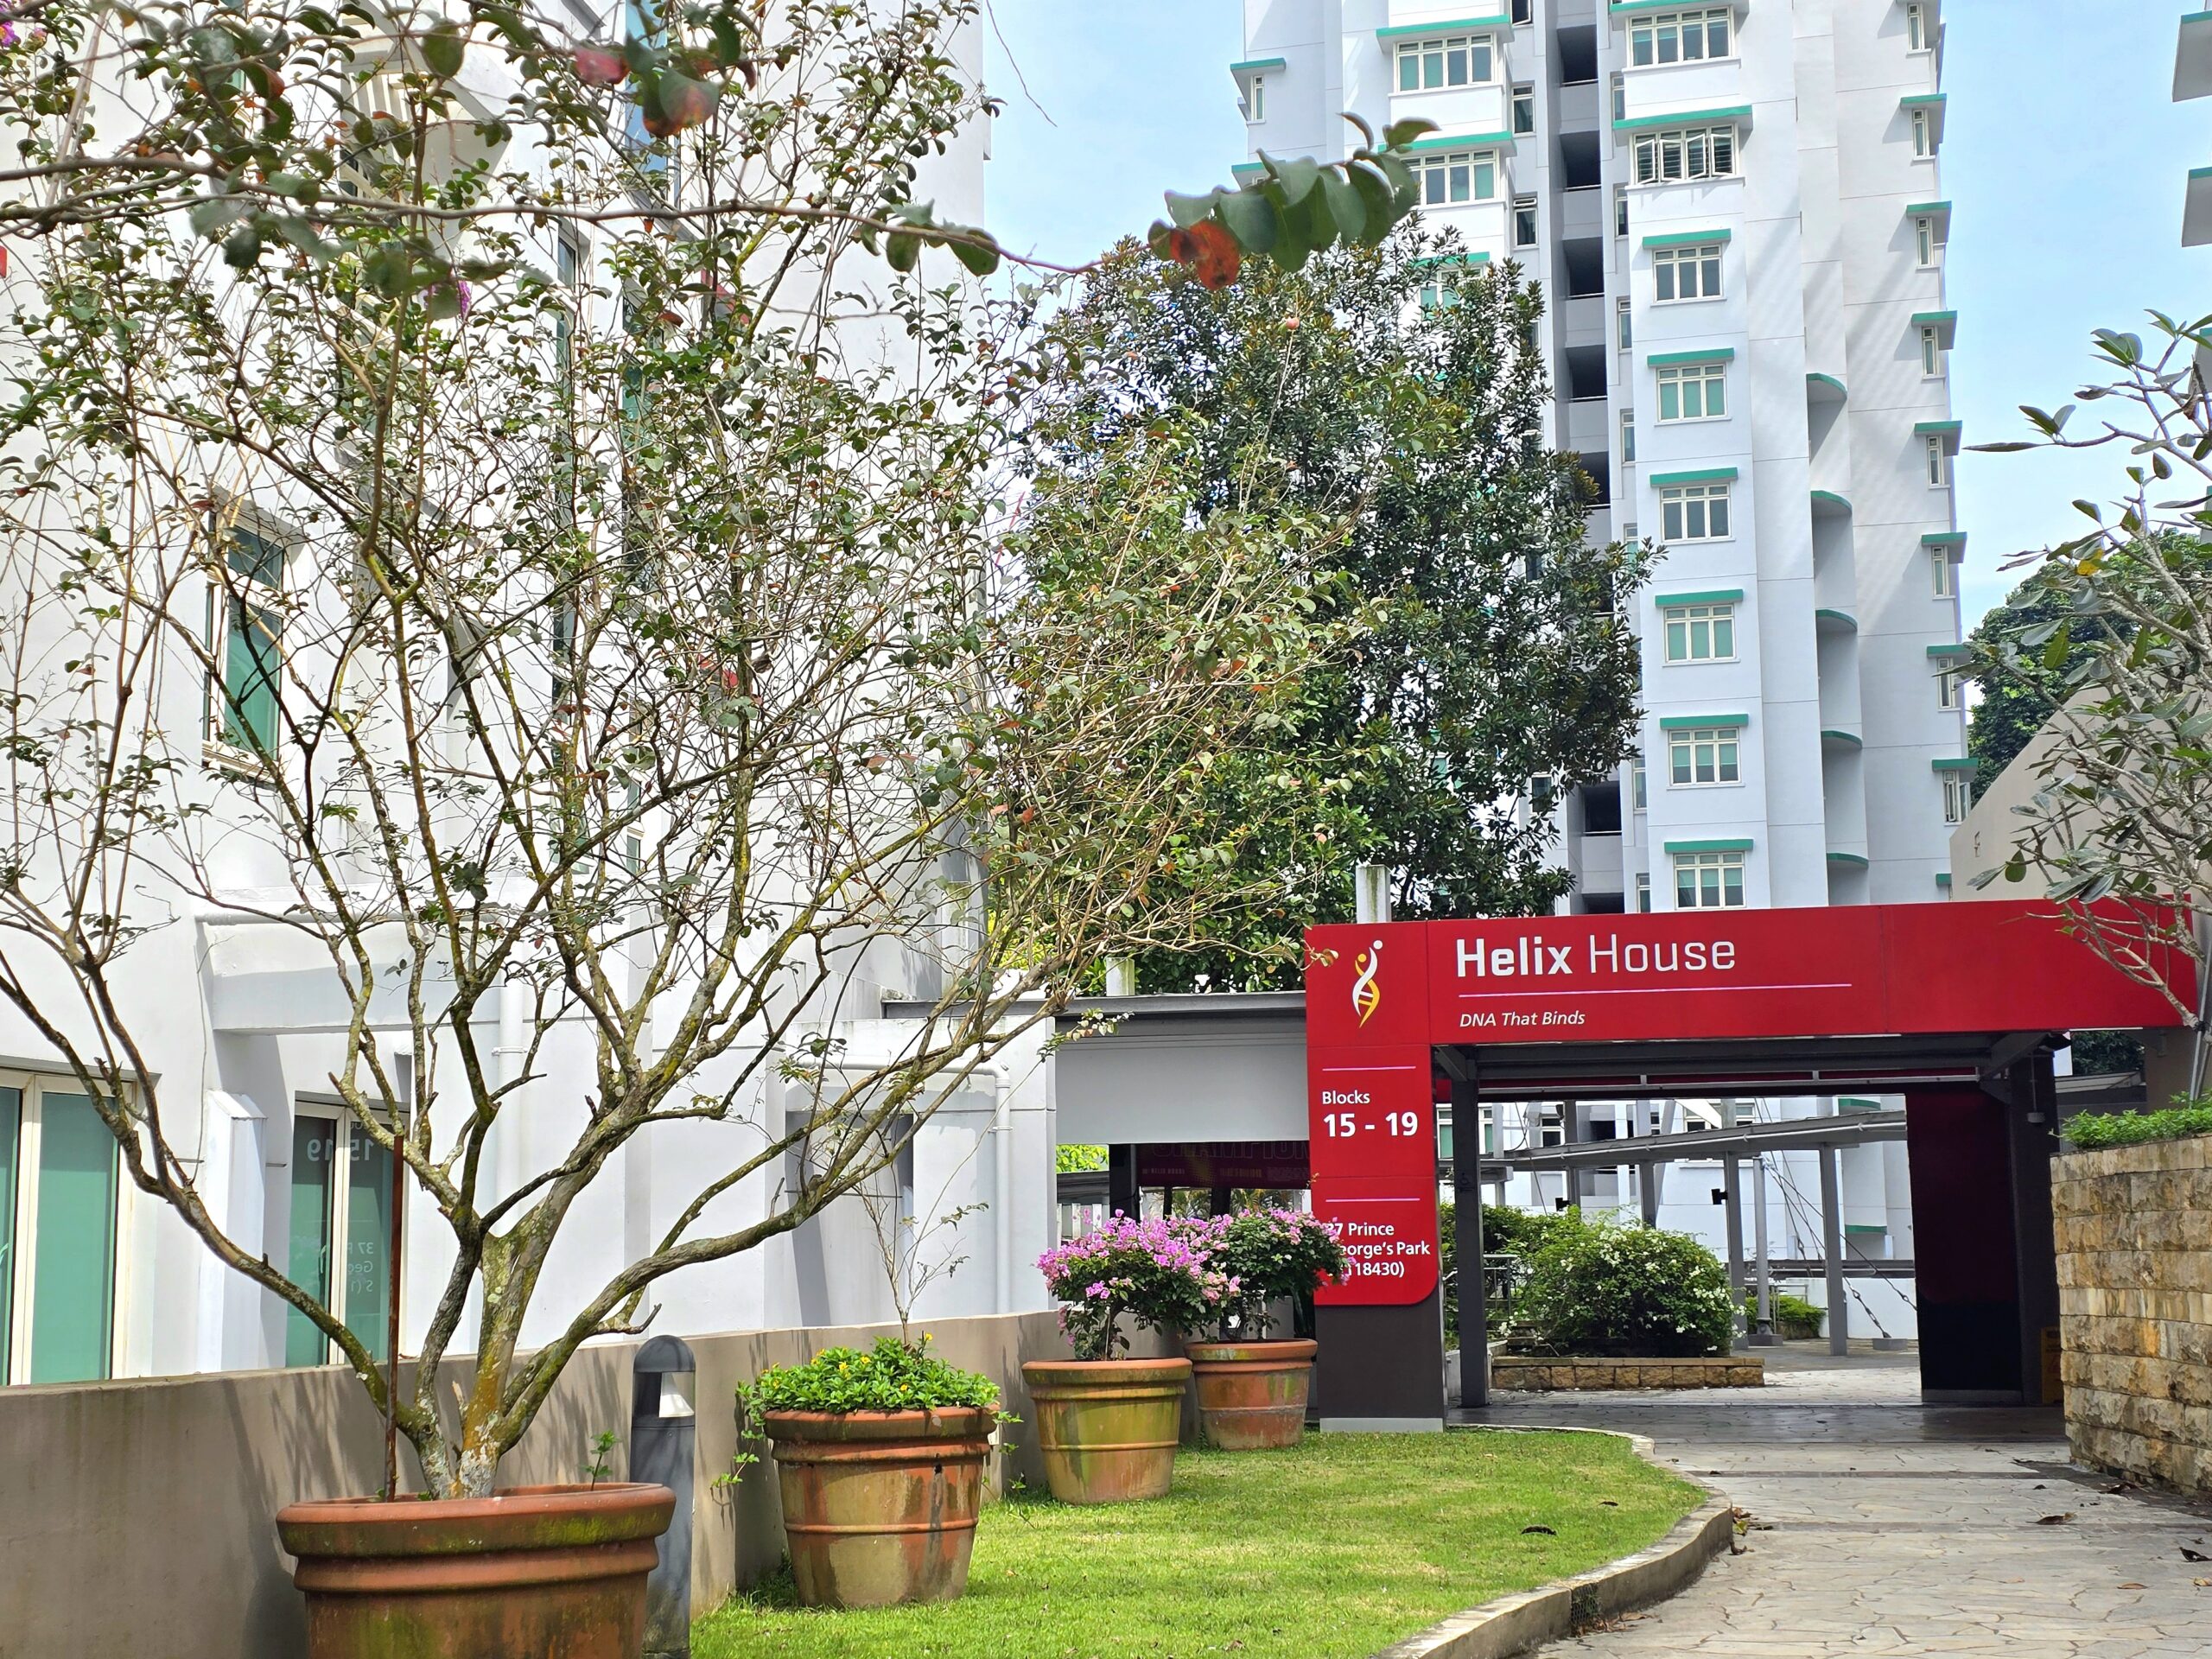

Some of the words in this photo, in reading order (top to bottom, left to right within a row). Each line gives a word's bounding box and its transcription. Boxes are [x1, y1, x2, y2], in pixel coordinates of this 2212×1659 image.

[1456, 936, 1573, 977] Helix
[1589, 933, 1736, 974] House
[1459, 1013, 1497, 1027] DNA
[1501, 1011, 1538, 1027] That
[1541, 1009, 1586, 1026] Binds
[1322, 1090, 1370, 1105] Blocks
[1323, 1113, 1357, 1137] 15
[1385, 1112, 1418, 1136] 19
[1348, 1222, 1395, 1236] Prince
[1339, 1242, 1394, 1259] eorge's
[1396, 1240, 1431, 1255] Park
[1340, 1262, 1405, 1278] 118430)
